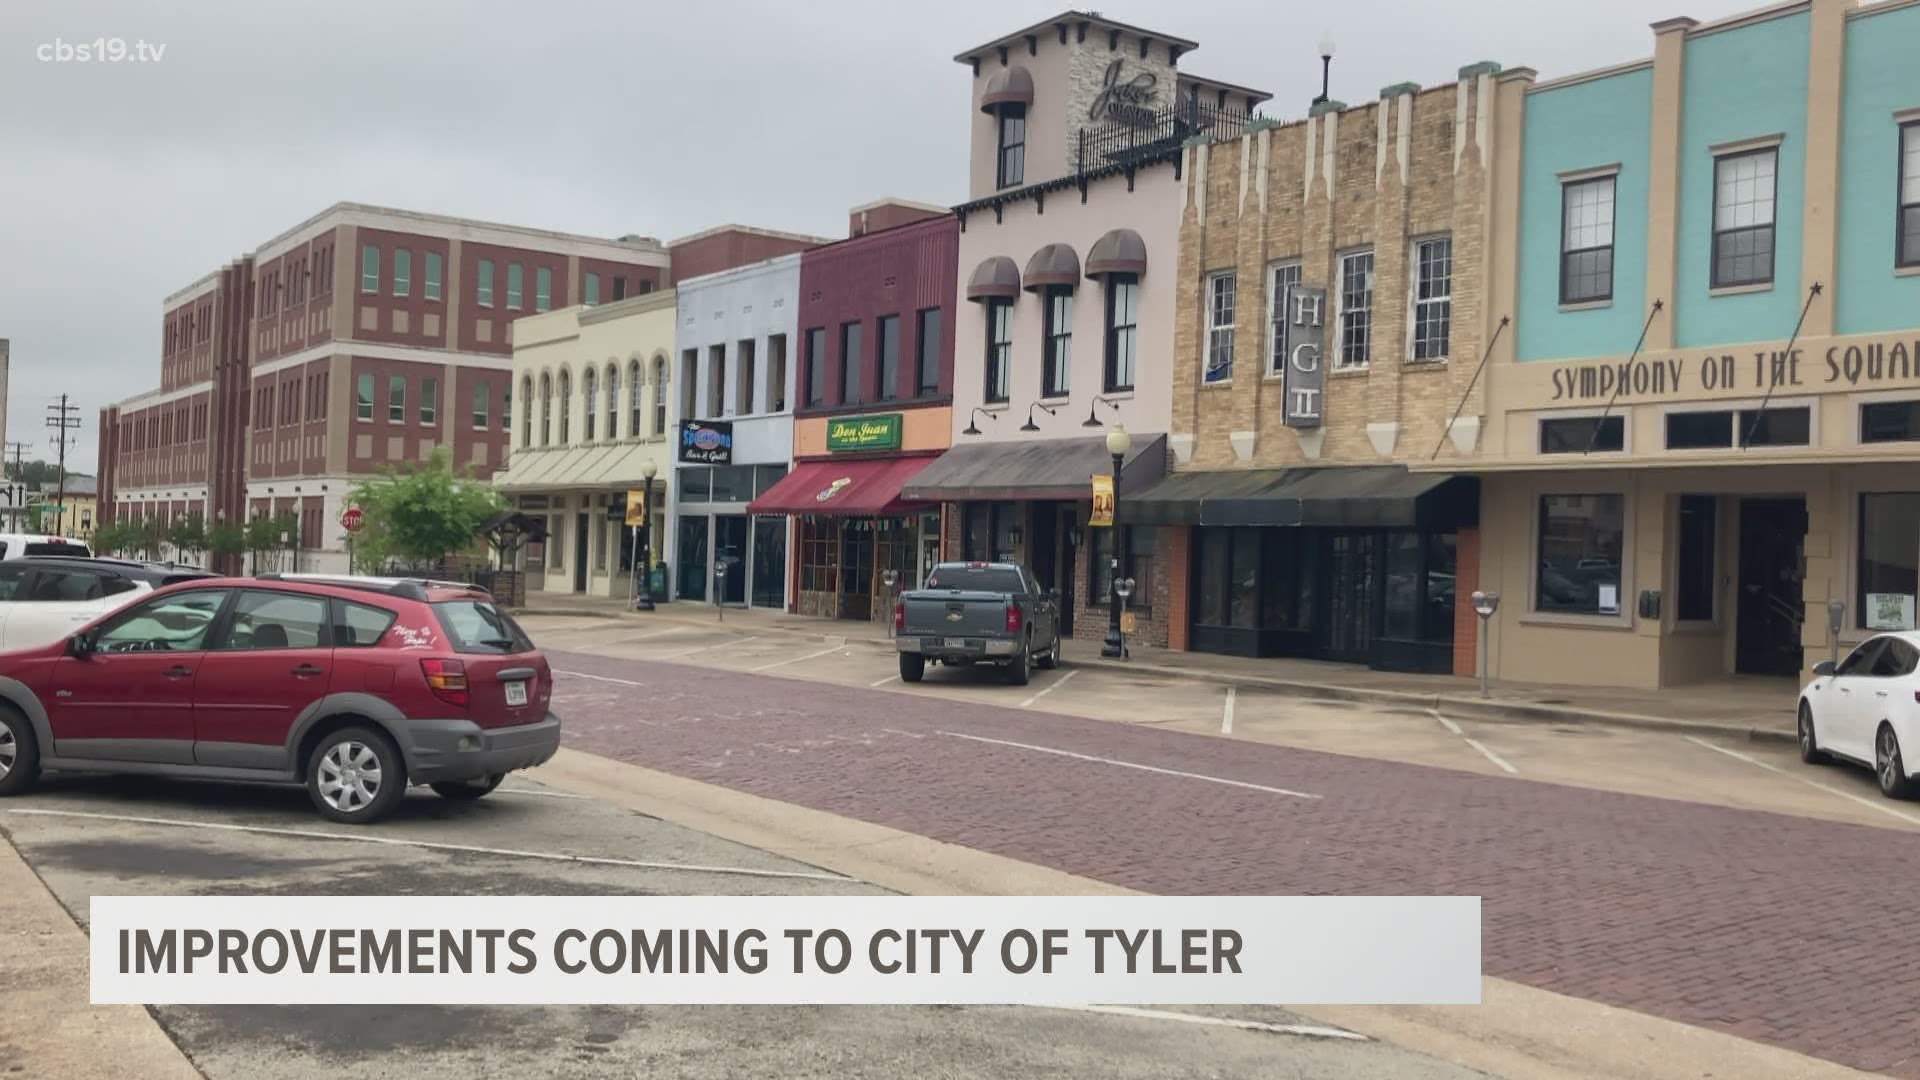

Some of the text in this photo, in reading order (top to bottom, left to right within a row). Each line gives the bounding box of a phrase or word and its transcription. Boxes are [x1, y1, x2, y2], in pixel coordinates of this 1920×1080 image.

[1552, 359, 1683, 400] SYMPHONY
[1701, 355, 1735, 389] ON
[1755, 349, 1803, 387] THE
[832, 423, 888, 438] Don Juan
